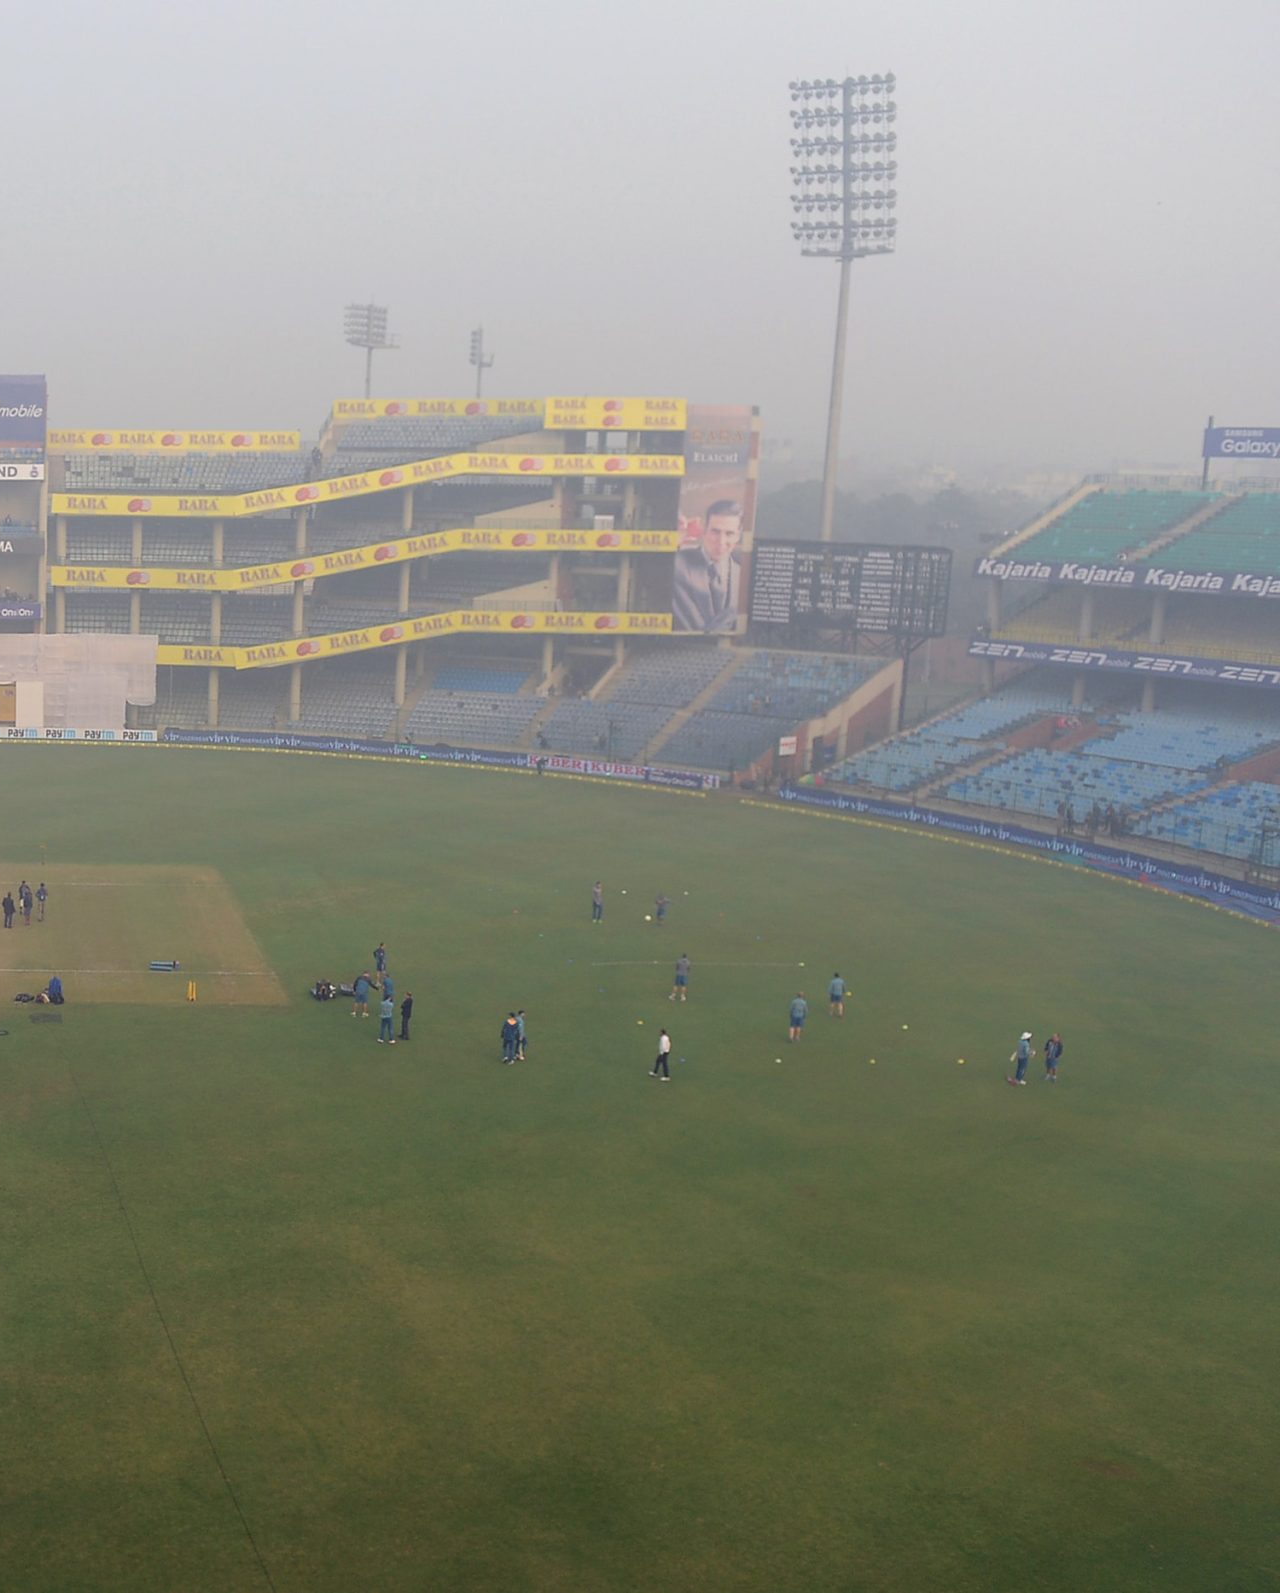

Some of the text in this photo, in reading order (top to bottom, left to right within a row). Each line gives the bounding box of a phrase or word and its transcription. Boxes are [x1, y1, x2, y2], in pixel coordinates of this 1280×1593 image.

[978, 559, 1051, 580] Kajaria
[1059, 563, 1135, 585] Kajaria
[1144, 568, 1224, 590] Kajaria
[1231, 573, 1280, 596] Kaja
[591, 761, 646, 776] KUBER
